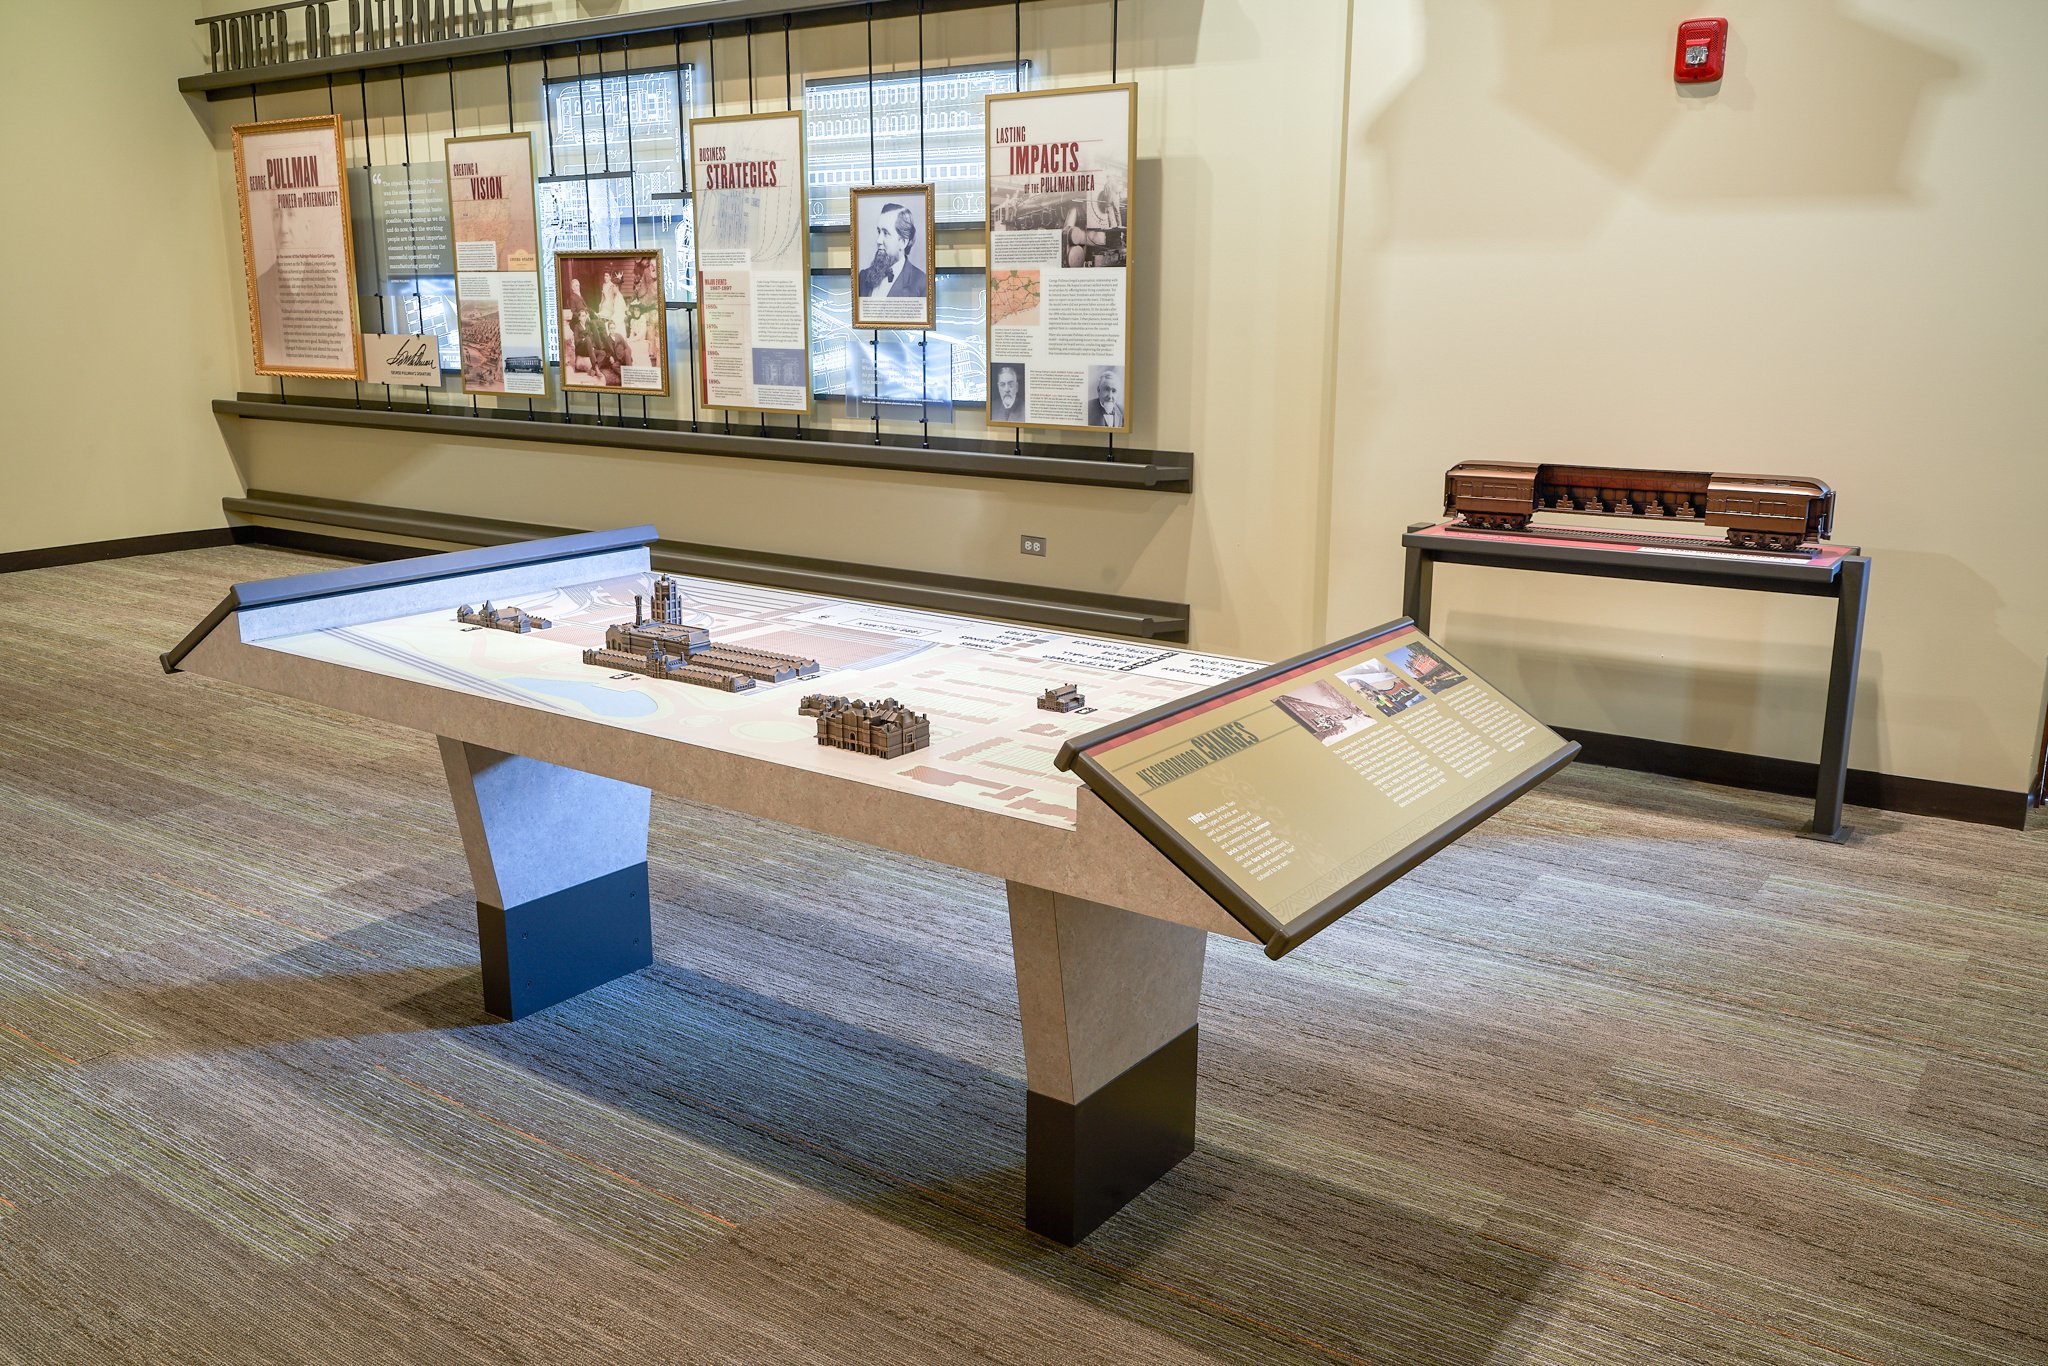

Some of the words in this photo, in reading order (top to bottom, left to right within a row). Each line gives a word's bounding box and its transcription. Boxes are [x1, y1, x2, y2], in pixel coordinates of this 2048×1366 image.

[209, 10, 290, 73] PIONEER
[304, 2, 332, 60] OR
[996, 126, 1026, 144] LASTING
[699, 146, 726, 161] BUSINESS
[1010, 142, 1079, 175] IMPACTS
[250, 175, 267, 191] GEORGE
[267, 155, 318, 189] PULLMAN
[453, 163, 474, 176] CREATING
[475, 163, 479, 175] A
[707, 160, 776, 190] STRATEGIES
[470, 176, 502, 200] VISION
[1024, 183, 1030, 194] OF
[1031, 183, 1039, 193] THE
[1040, 175, 1075, 193] PULLMAN
[1078, 175, 1095, 191] IDEA
[277, 194, 297, 208] PIONEER
[303, 191, 338, 207] PATERNALIST?
[1190, 657, 1244, 669] BUILDING
[1190, 664, 1244, 675] BUILDING
[1161, 667, 1215, 678] FACTORY
[1135, 748, 1208, 788] NEIGHBORHOOD
[1190, 721, 1259, 761] CHANGES
